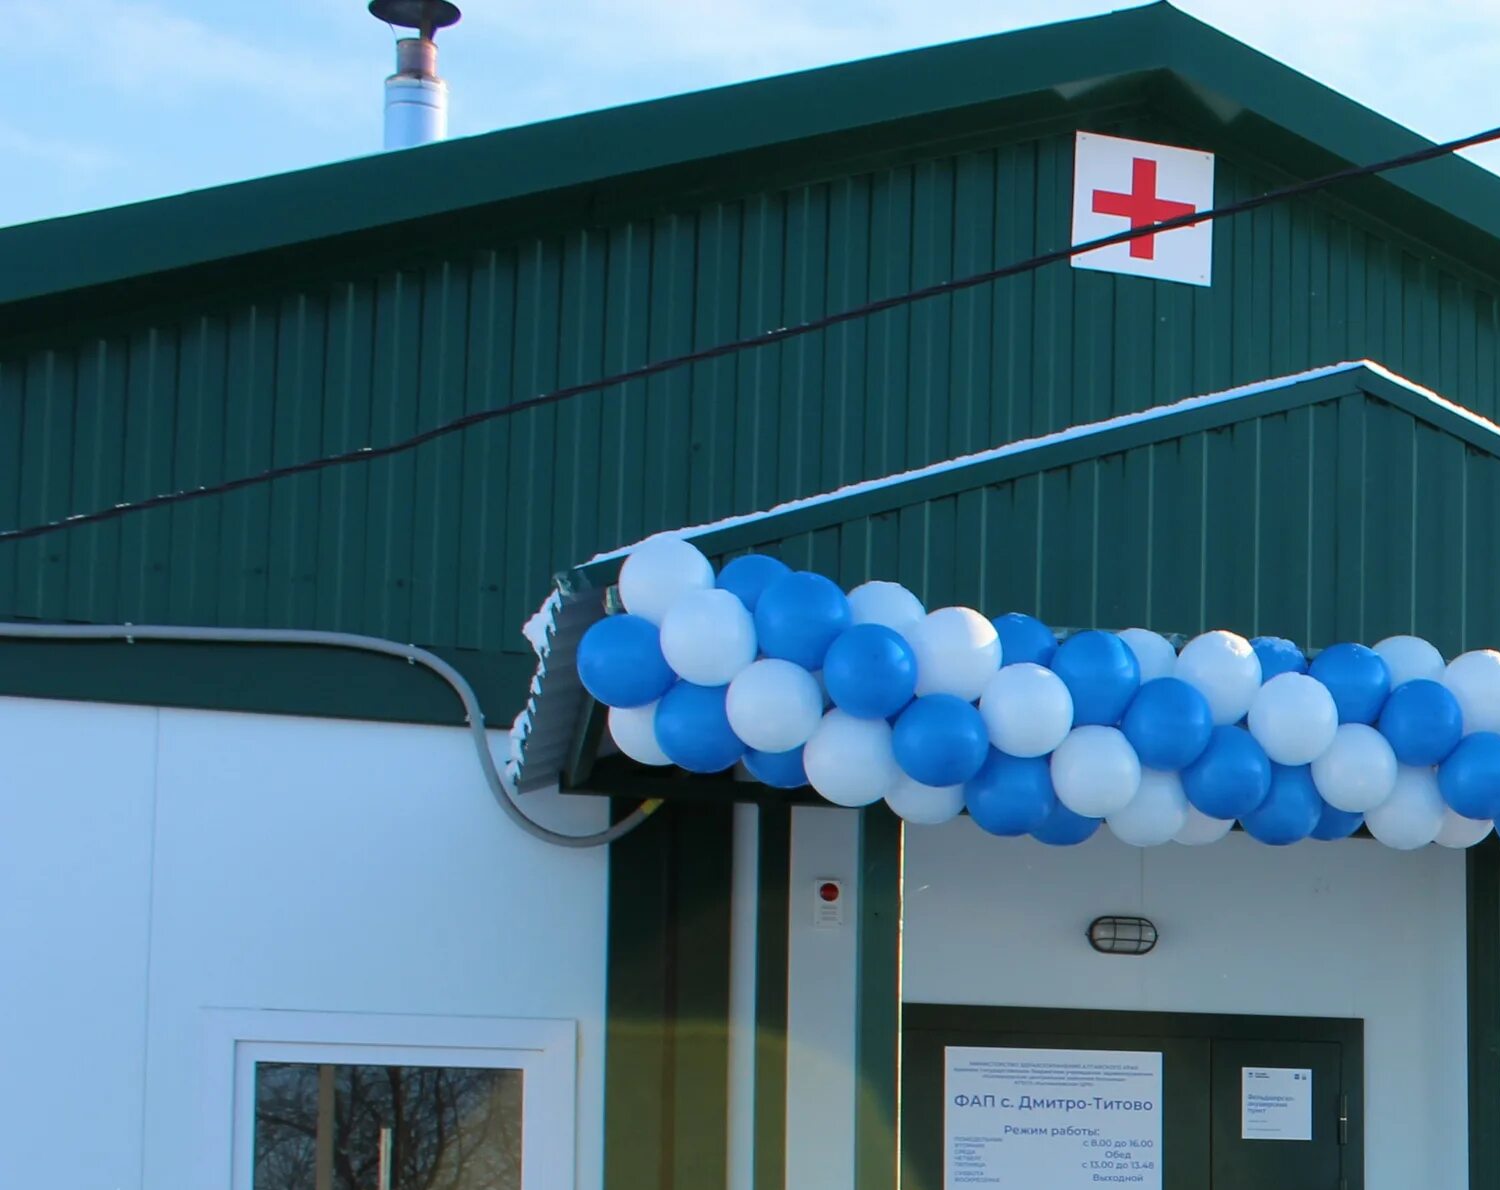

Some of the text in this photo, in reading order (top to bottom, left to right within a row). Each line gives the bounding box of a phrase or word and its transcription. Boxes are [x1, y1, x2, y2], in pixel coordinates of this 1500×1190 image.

[954, 1094, 1154, 1112] ФАП с. Дмитро-Титово
[1004, 1125, 1100, 1138] Режим работы:
[1091, 1139, 1112, 1148] 8.00
[1114, 1140, 1127, 1148] до
[1130, 1139, 1154, 1148] 16.00
[1104, 1150, 1132, 1159] Обед
[1090, 1160, 1114, 1169] 13.00
[1115, 1162, 1129, 1170] до
[1092, 1173, 1144, 1183] Выходной
